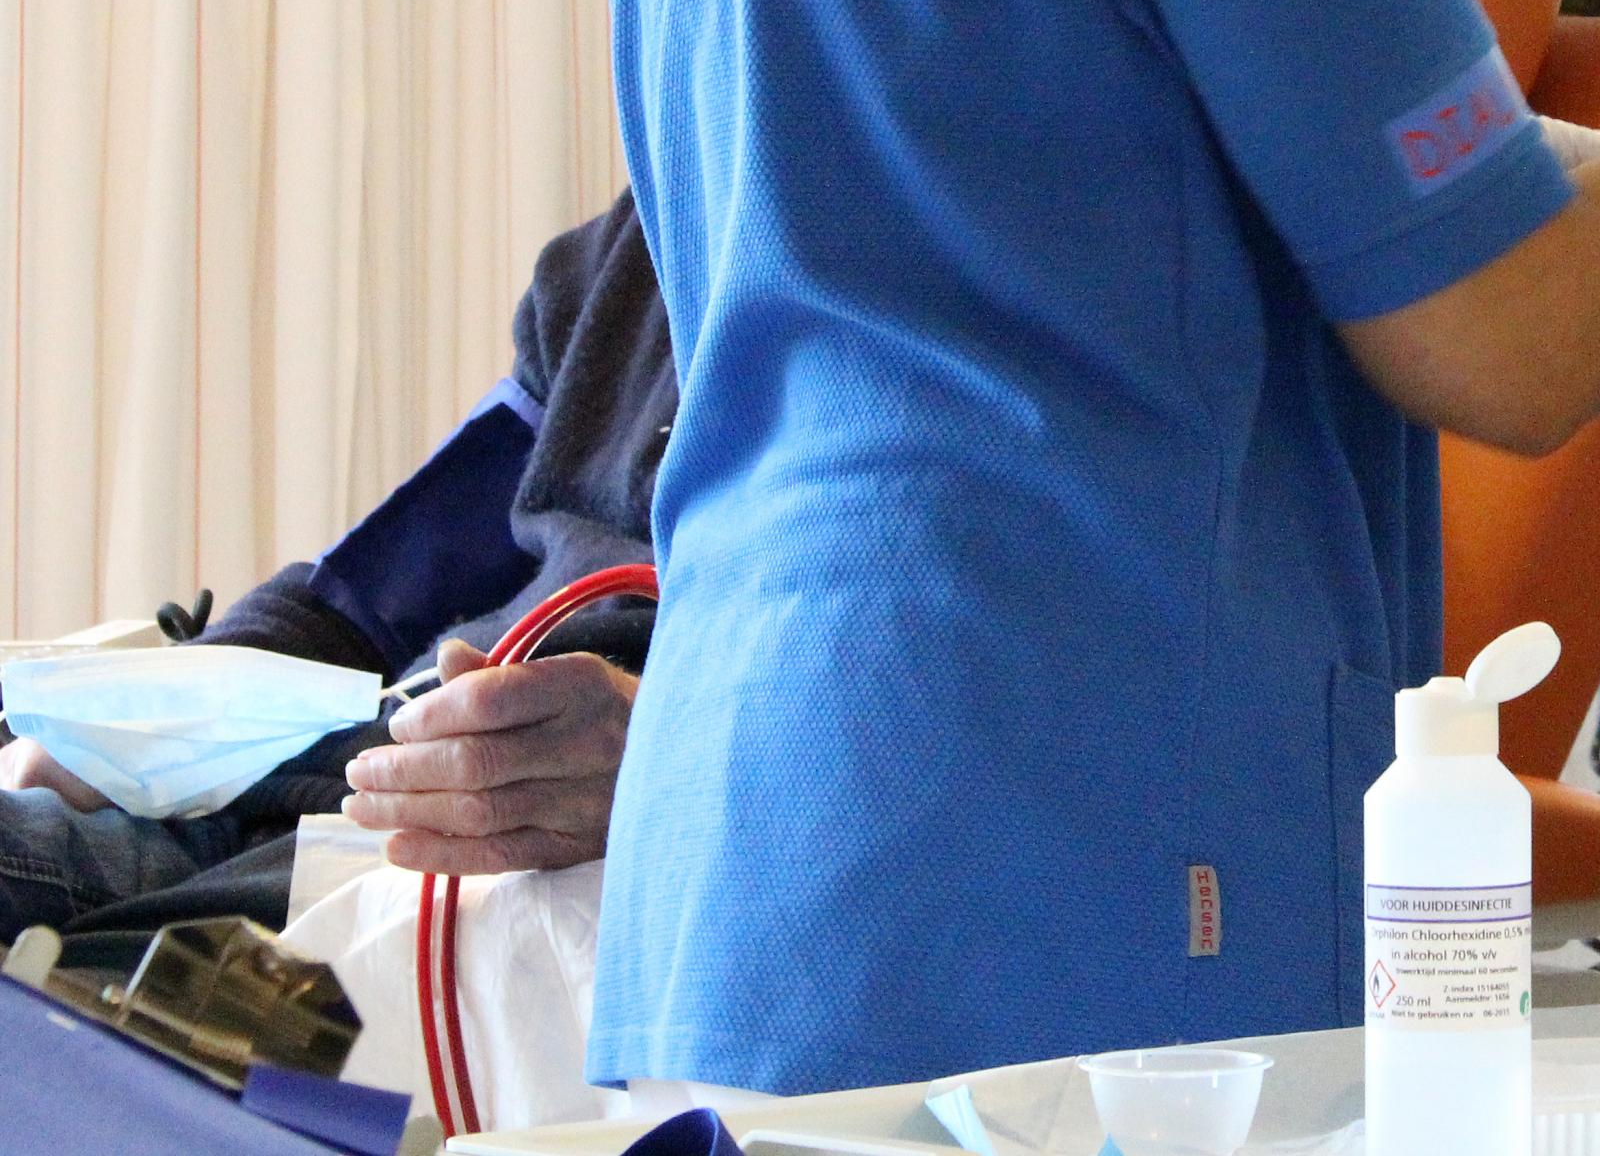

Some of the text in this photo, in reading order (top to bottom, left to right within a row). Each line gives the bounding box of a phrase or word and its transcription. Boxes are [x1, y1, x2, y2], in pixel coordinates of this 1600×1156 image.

[1380, 897, 1513, 913] VOOR HUIDDESINFECTIE
[1411, 928, 1502, 942] Chloorhexidine
[1391, 948, 1498, 962] in alcohol 70% v/v
[1396, 995, 1431, 1007] 250 ml
